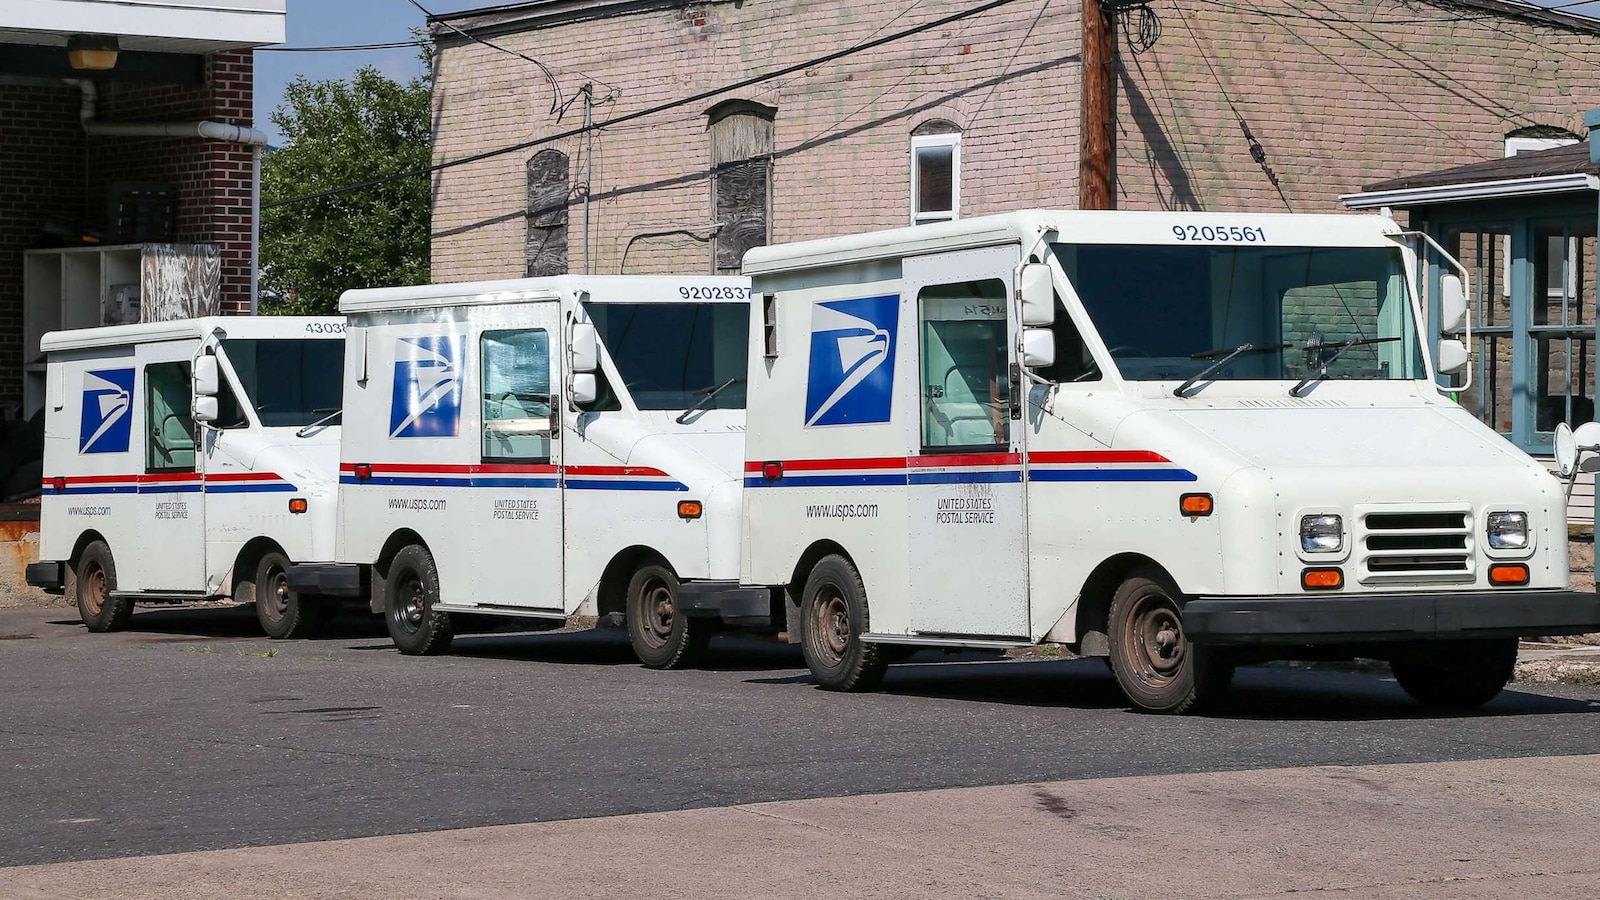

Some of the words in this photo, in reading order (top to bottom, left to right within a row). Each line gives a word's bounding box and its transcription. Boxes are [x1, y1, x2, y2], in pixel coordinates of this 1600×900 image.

[1172, 225, 1266, 242] 9205561
[679, 286, 752, 300] 9202837
[155, 502, 172, 510] UNITED
[172, 502, 187, 510] STATES
[388, 498, 447, 513] www.usps.com
[494, 499, 516, 509] UNITED
[516, 499, 537, 509] STATES
[937, 498, 965, 510] UNITED
[966, 498, 992, 510] STATES
[68, 506, 111, 518] www.usps.com
[155, 511, 171, 520] POSTAL
[171, 511, 189, 519] SERVICE
[493, 511, 515, 520] POSTAL
[515, 511, 539, 521] SERVICE
[806, 503, 879, 522] www.usps.com
[936, 512, 963, 524] POSTAL
[964, 512, 994, 524] SERVICE
